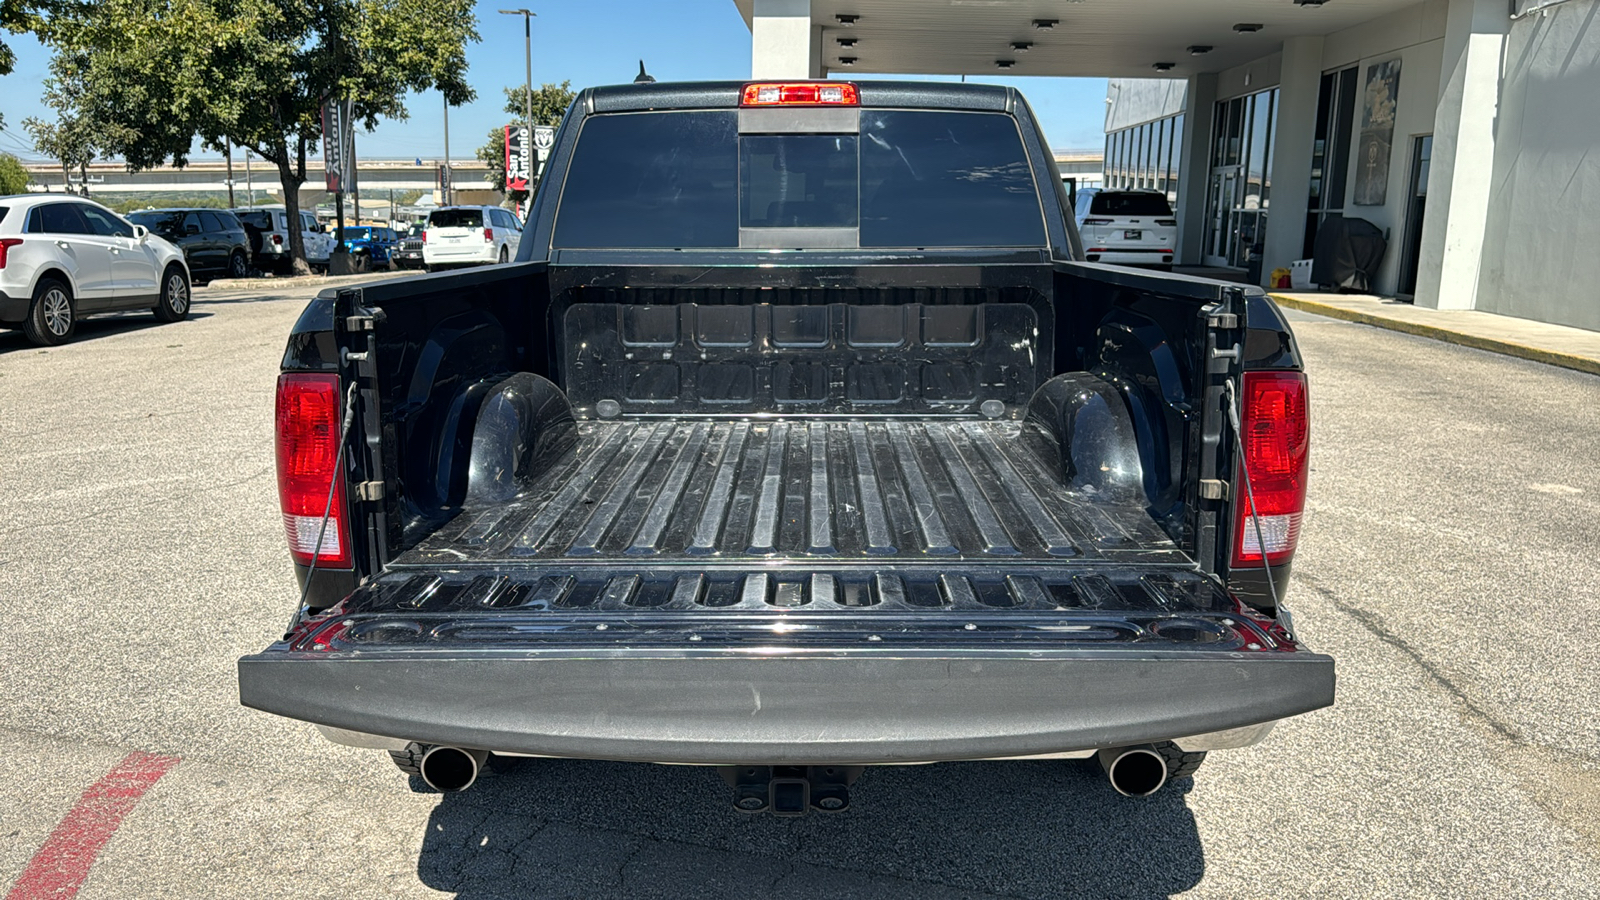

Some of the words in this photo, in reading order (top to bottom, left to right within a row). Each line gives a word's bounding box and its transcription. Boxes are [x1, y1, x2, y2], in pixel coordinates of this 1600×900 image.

[325, 137, 333, 174] San
[507, 154, 518, 179] San
[517, 128, 530, 179] Antonio
